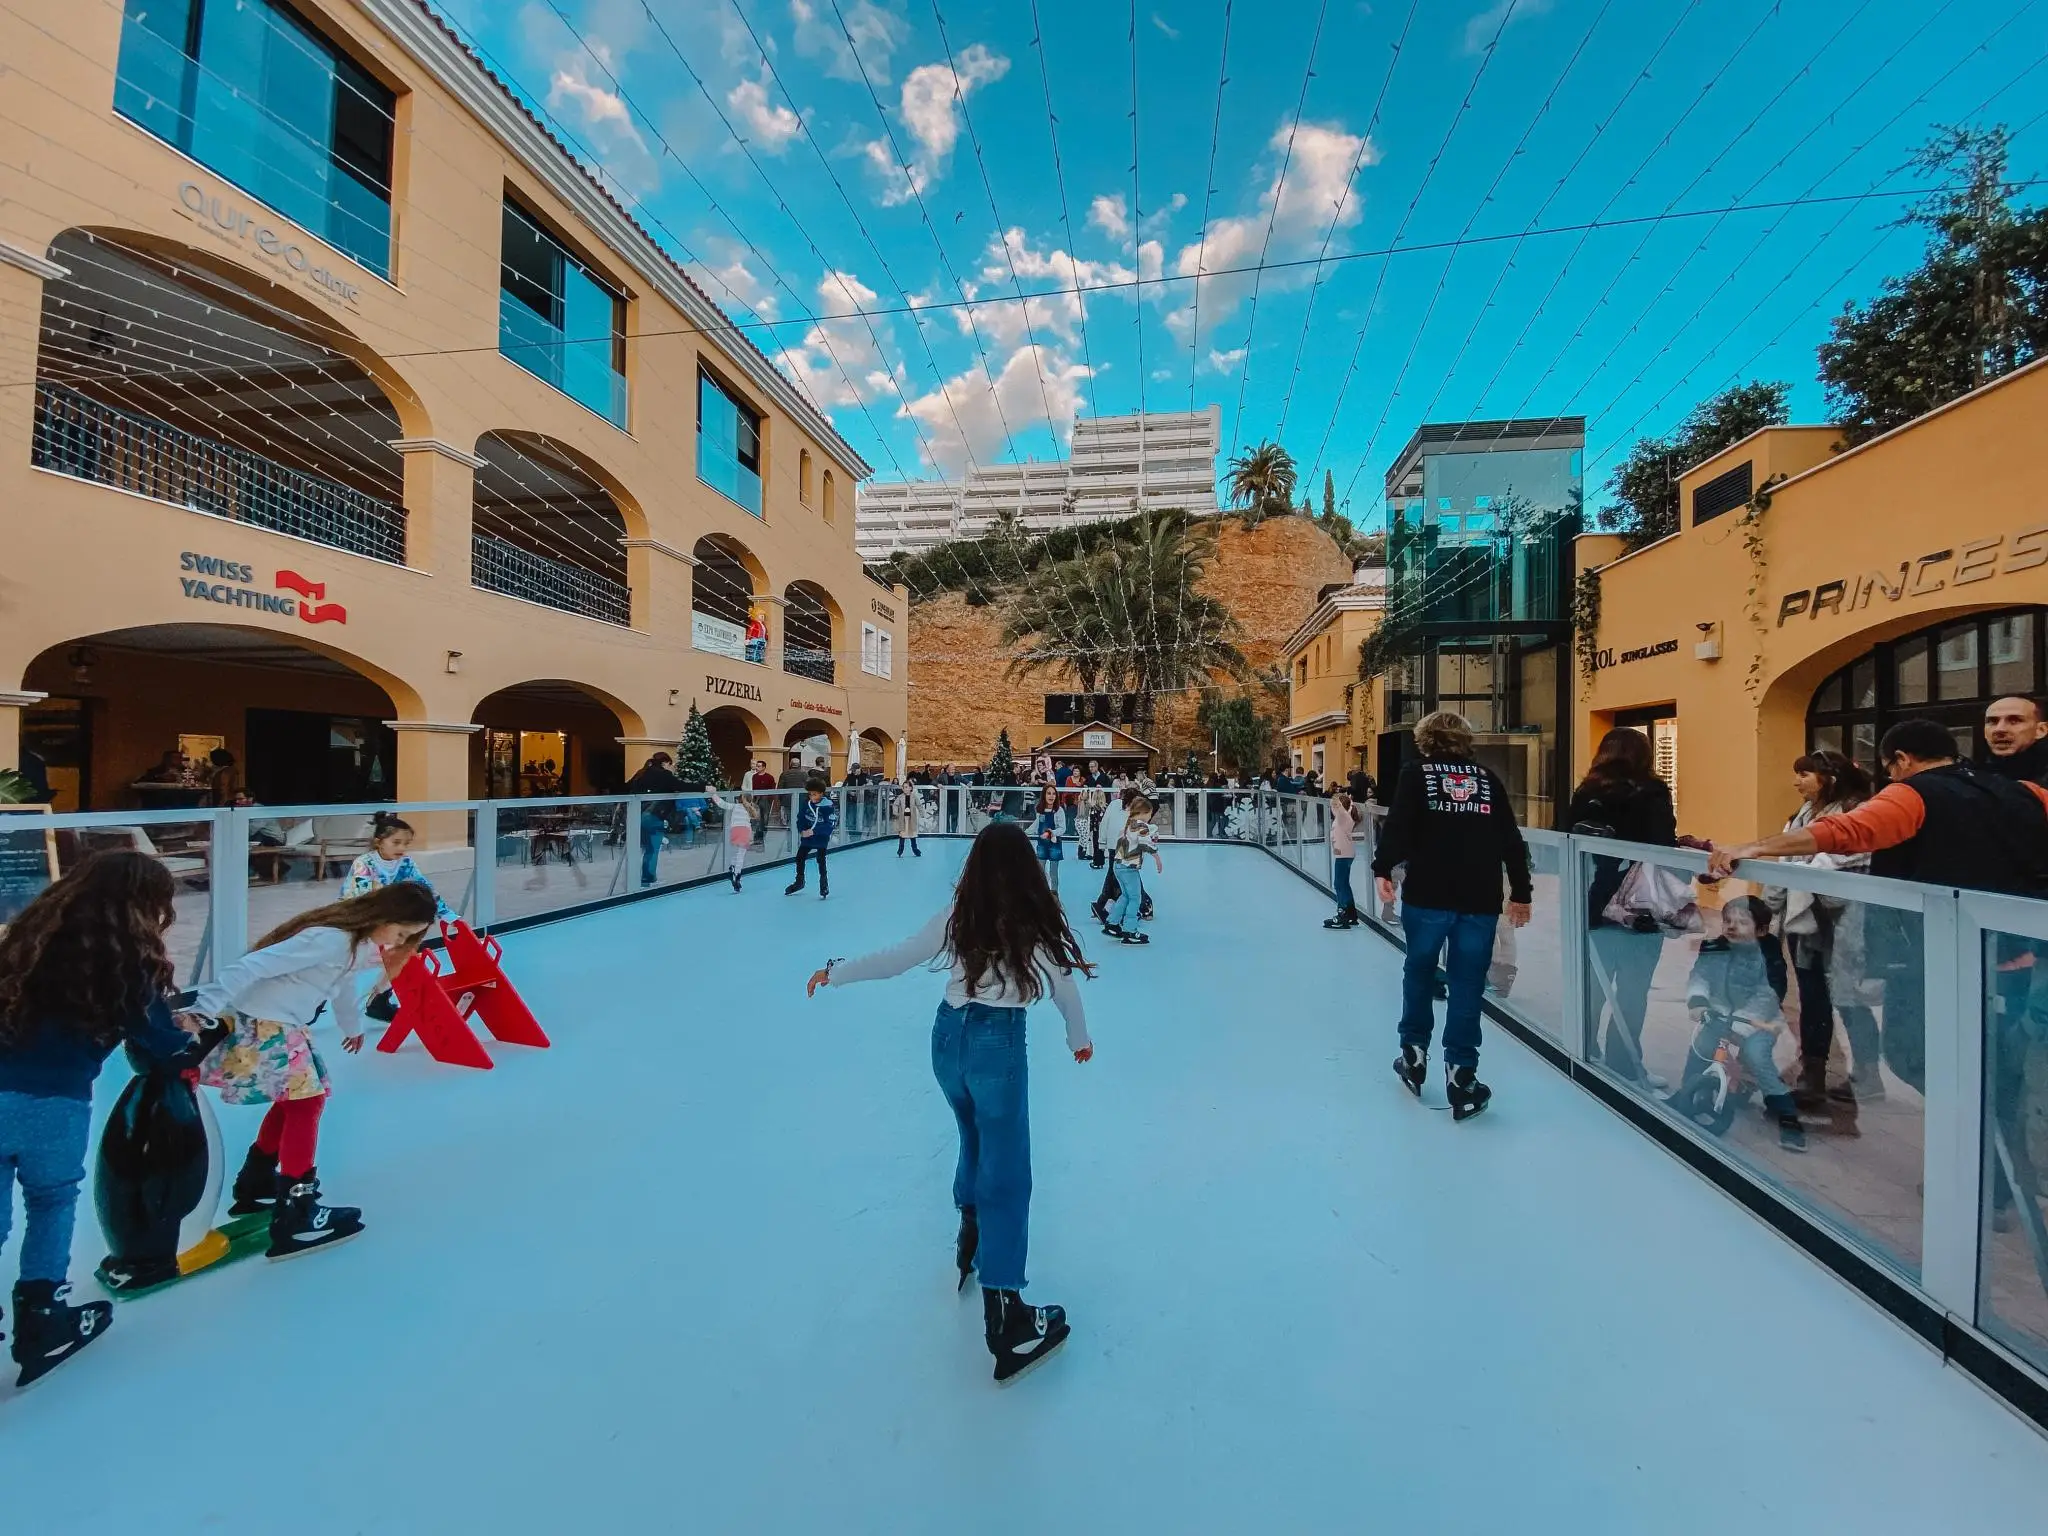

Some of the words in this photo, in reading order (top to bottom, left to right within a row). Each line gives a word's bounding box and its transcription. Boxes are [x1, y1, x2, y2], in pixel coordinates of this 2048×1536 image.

[180, 551, 254, 584] SWISS
[179, 576, 296, 617] YACHTING
[1620, 639, 1679, 664] SUNGLASSES
[705, 675, 763, 702] PIZZERIA
[1434, 763, 1478, 774] HURLEY
[1424, 774, 1438, 797] 1999
[1480, 779, 1491, 801] 1999
[1437, 800, 1480, 813] HURLEY
